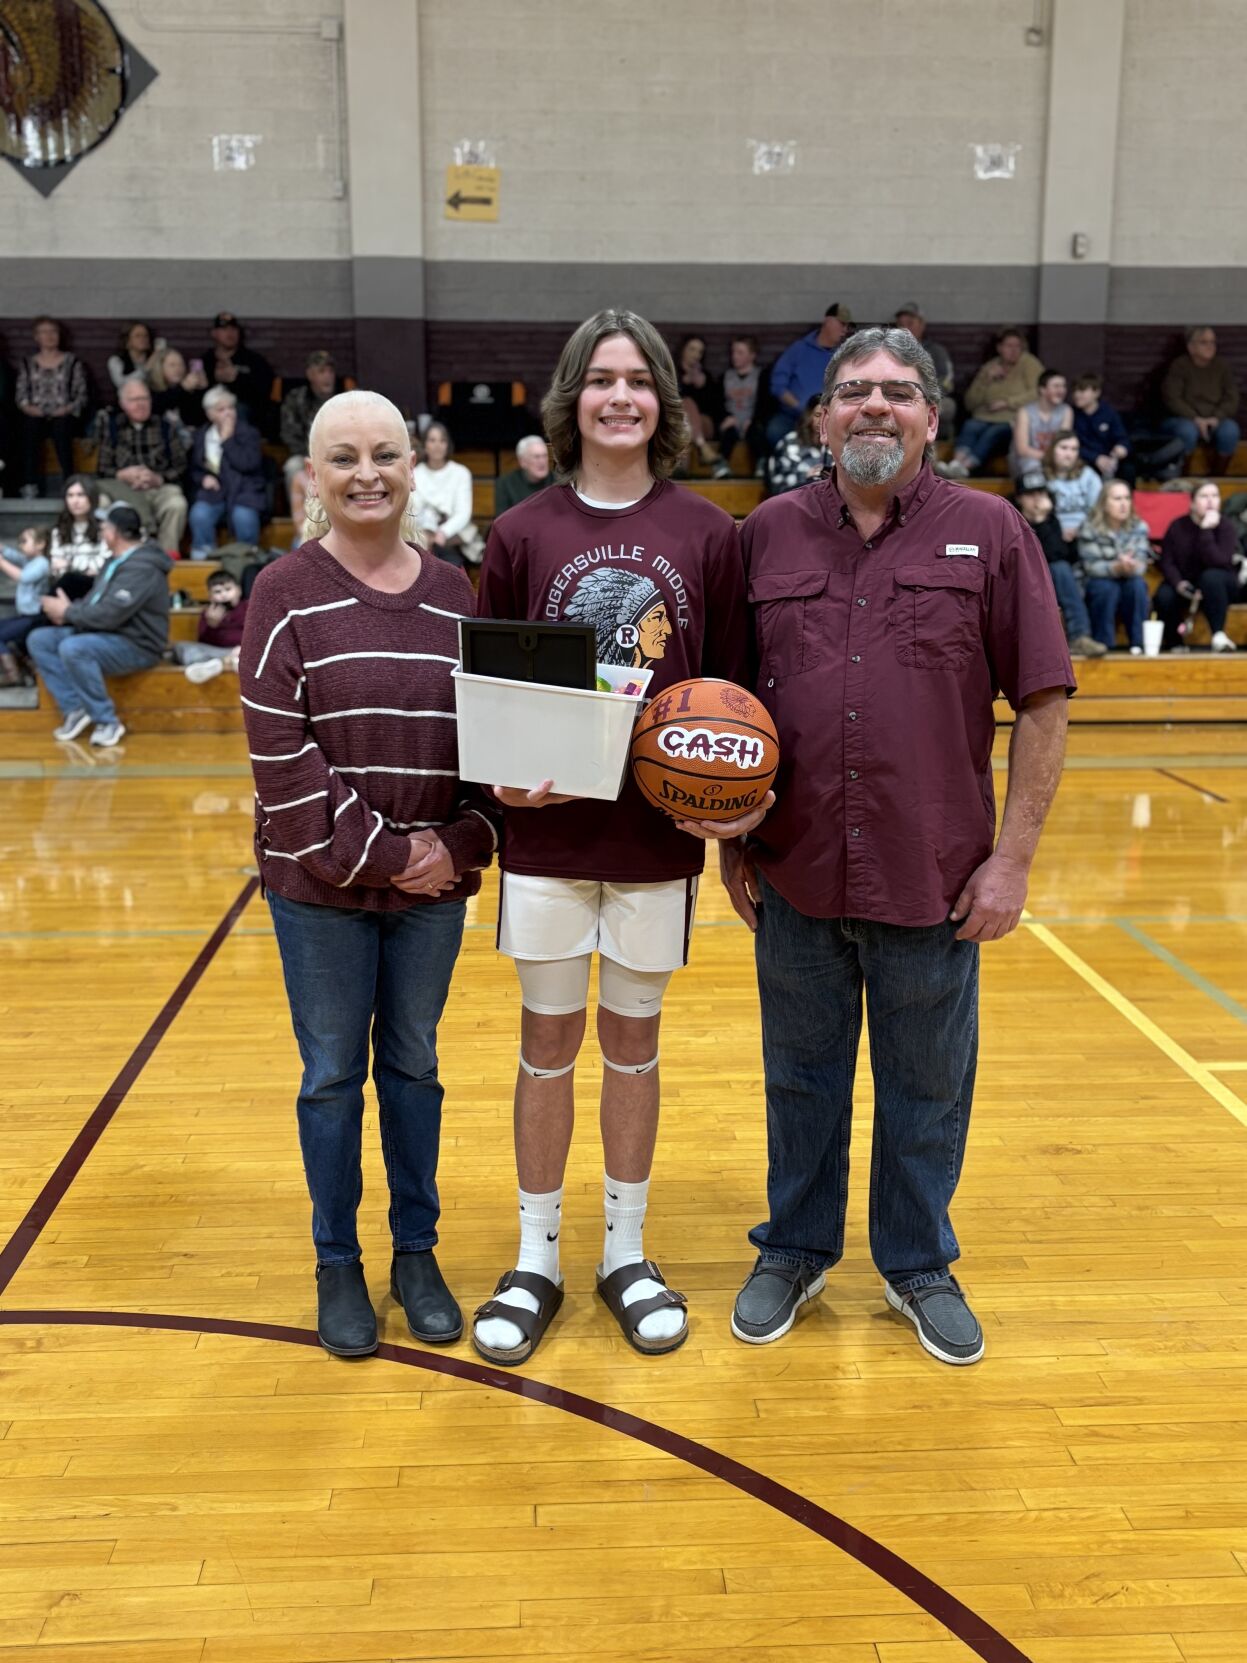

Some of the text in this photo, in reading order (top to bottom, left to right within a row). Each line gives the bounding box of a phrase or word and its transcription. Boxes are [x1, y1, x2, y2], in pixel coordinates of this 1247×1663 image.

[546, 544, 689, 630] OGERSVILLE MIDDLE
[620, 627, 635, 645] R
[652, 687, 693, 724] #1
[663, 730, 760, 767] CASH
[659, 780, 757, 811] SPALDING
